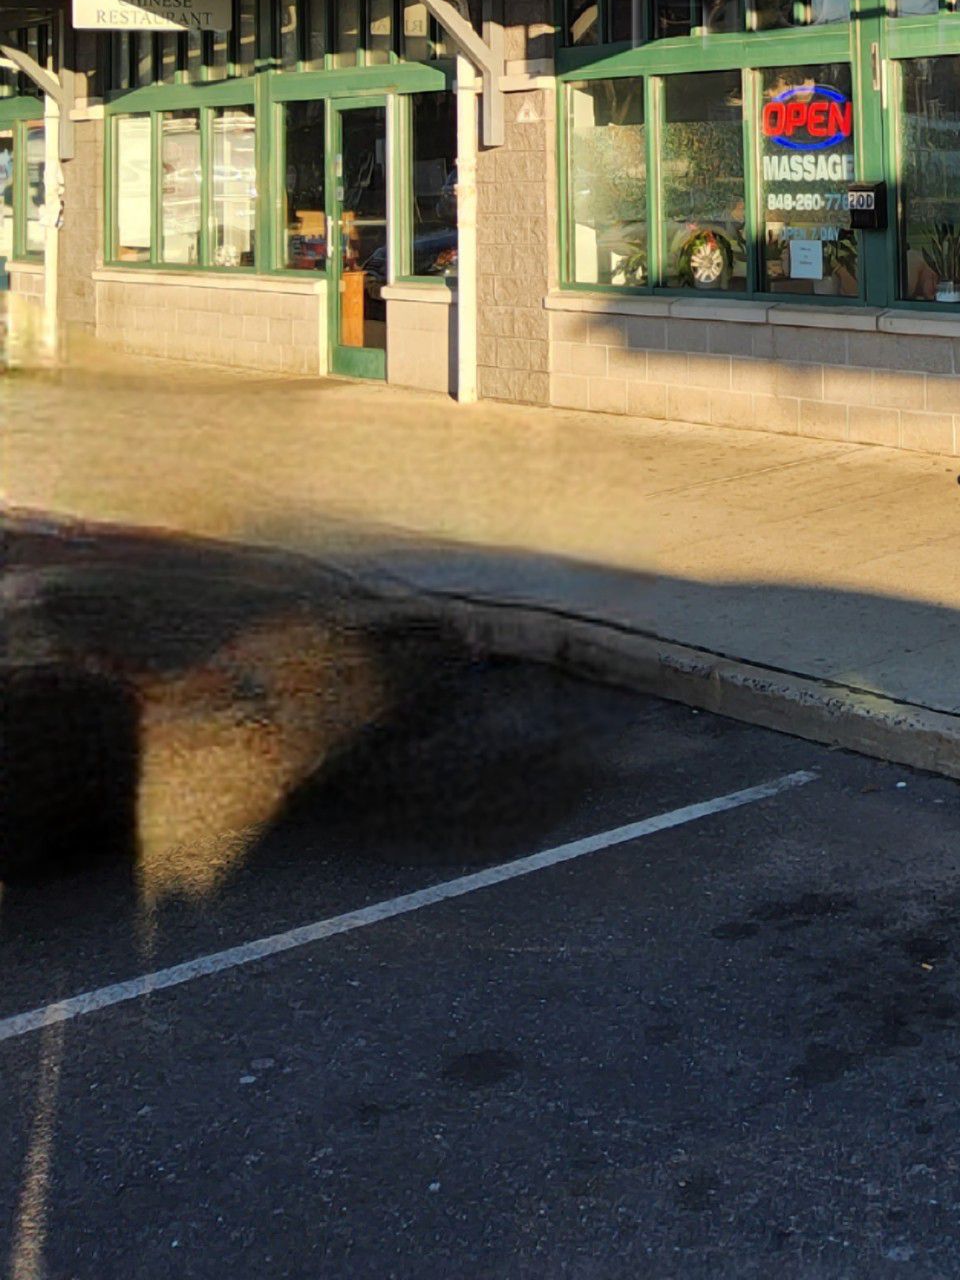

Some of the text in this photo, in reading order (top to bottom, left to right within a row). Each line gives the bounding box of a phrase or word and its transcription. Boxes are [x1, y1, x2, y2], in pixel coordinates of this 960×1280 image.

[96, 9, 213, 26] RESTAURANT
[762, 100, 851, 138] OPEN
[763, 154, 854, 182] MASSAGE
